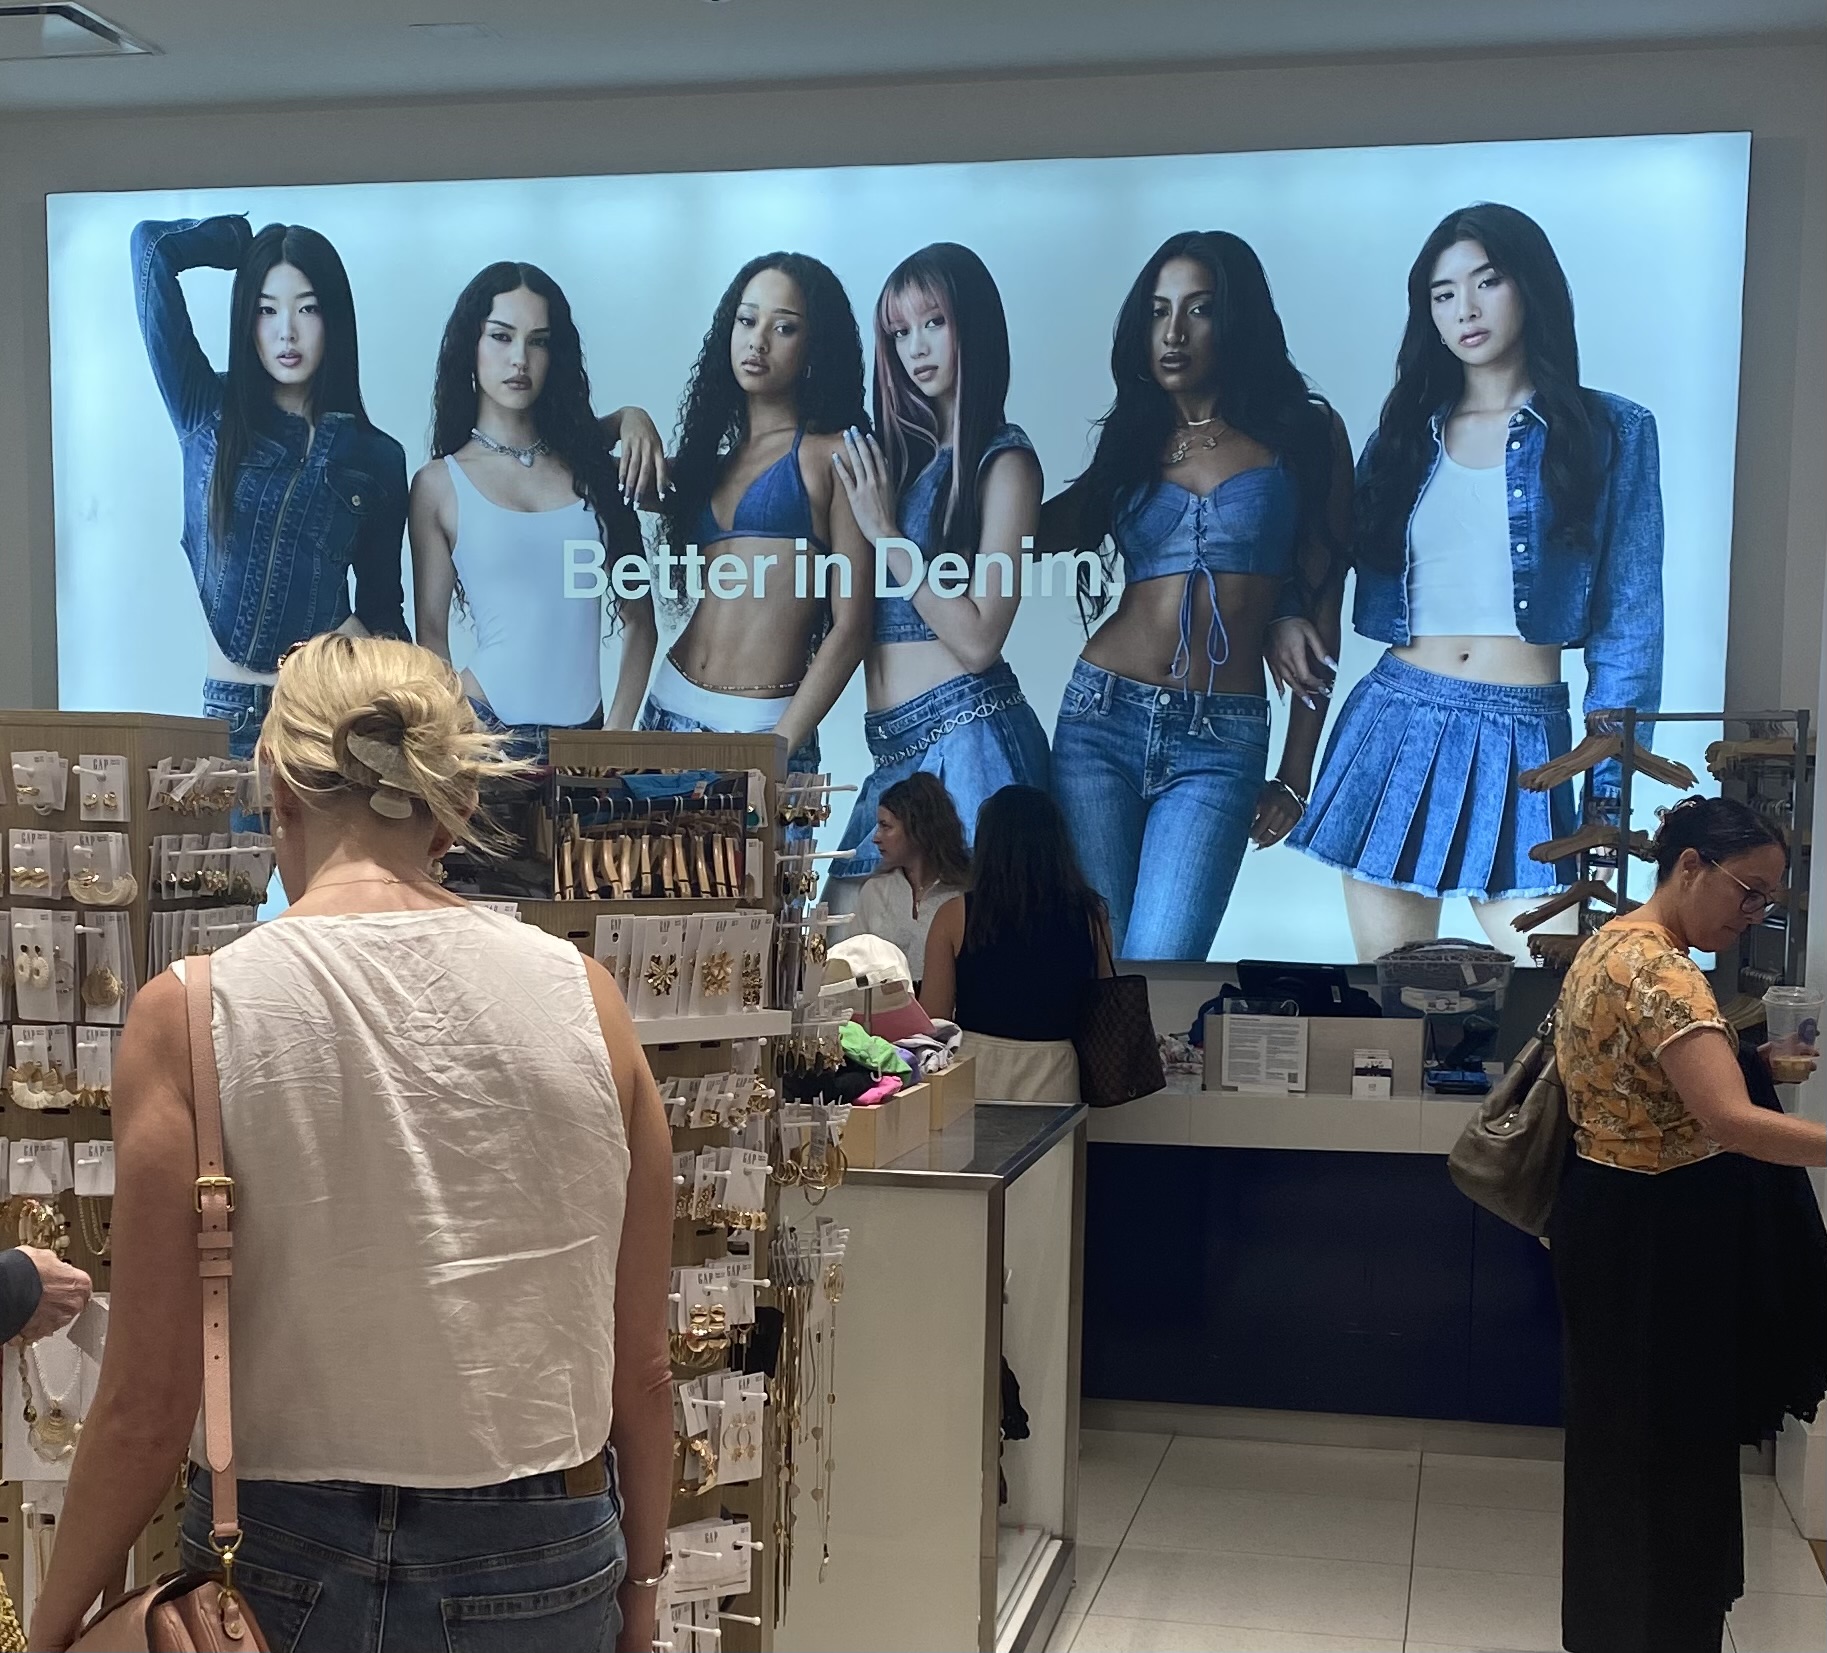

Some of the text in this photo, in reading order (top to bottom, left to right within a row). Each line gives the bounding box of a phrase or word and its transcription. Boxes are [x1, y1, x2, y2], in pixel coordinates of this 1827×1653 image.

[563, 535, 1122, 600] Better in Denim.
[93, 758, 108, 770] GAP
[22, 832, 36, 844] GAP
[743, 1152, 757, 1165] GAP
[726, 1263, 741, 1277] GAP
[697, 1272, 714, 1285] GAP
[704, 1530, 718, 1544] GAP
